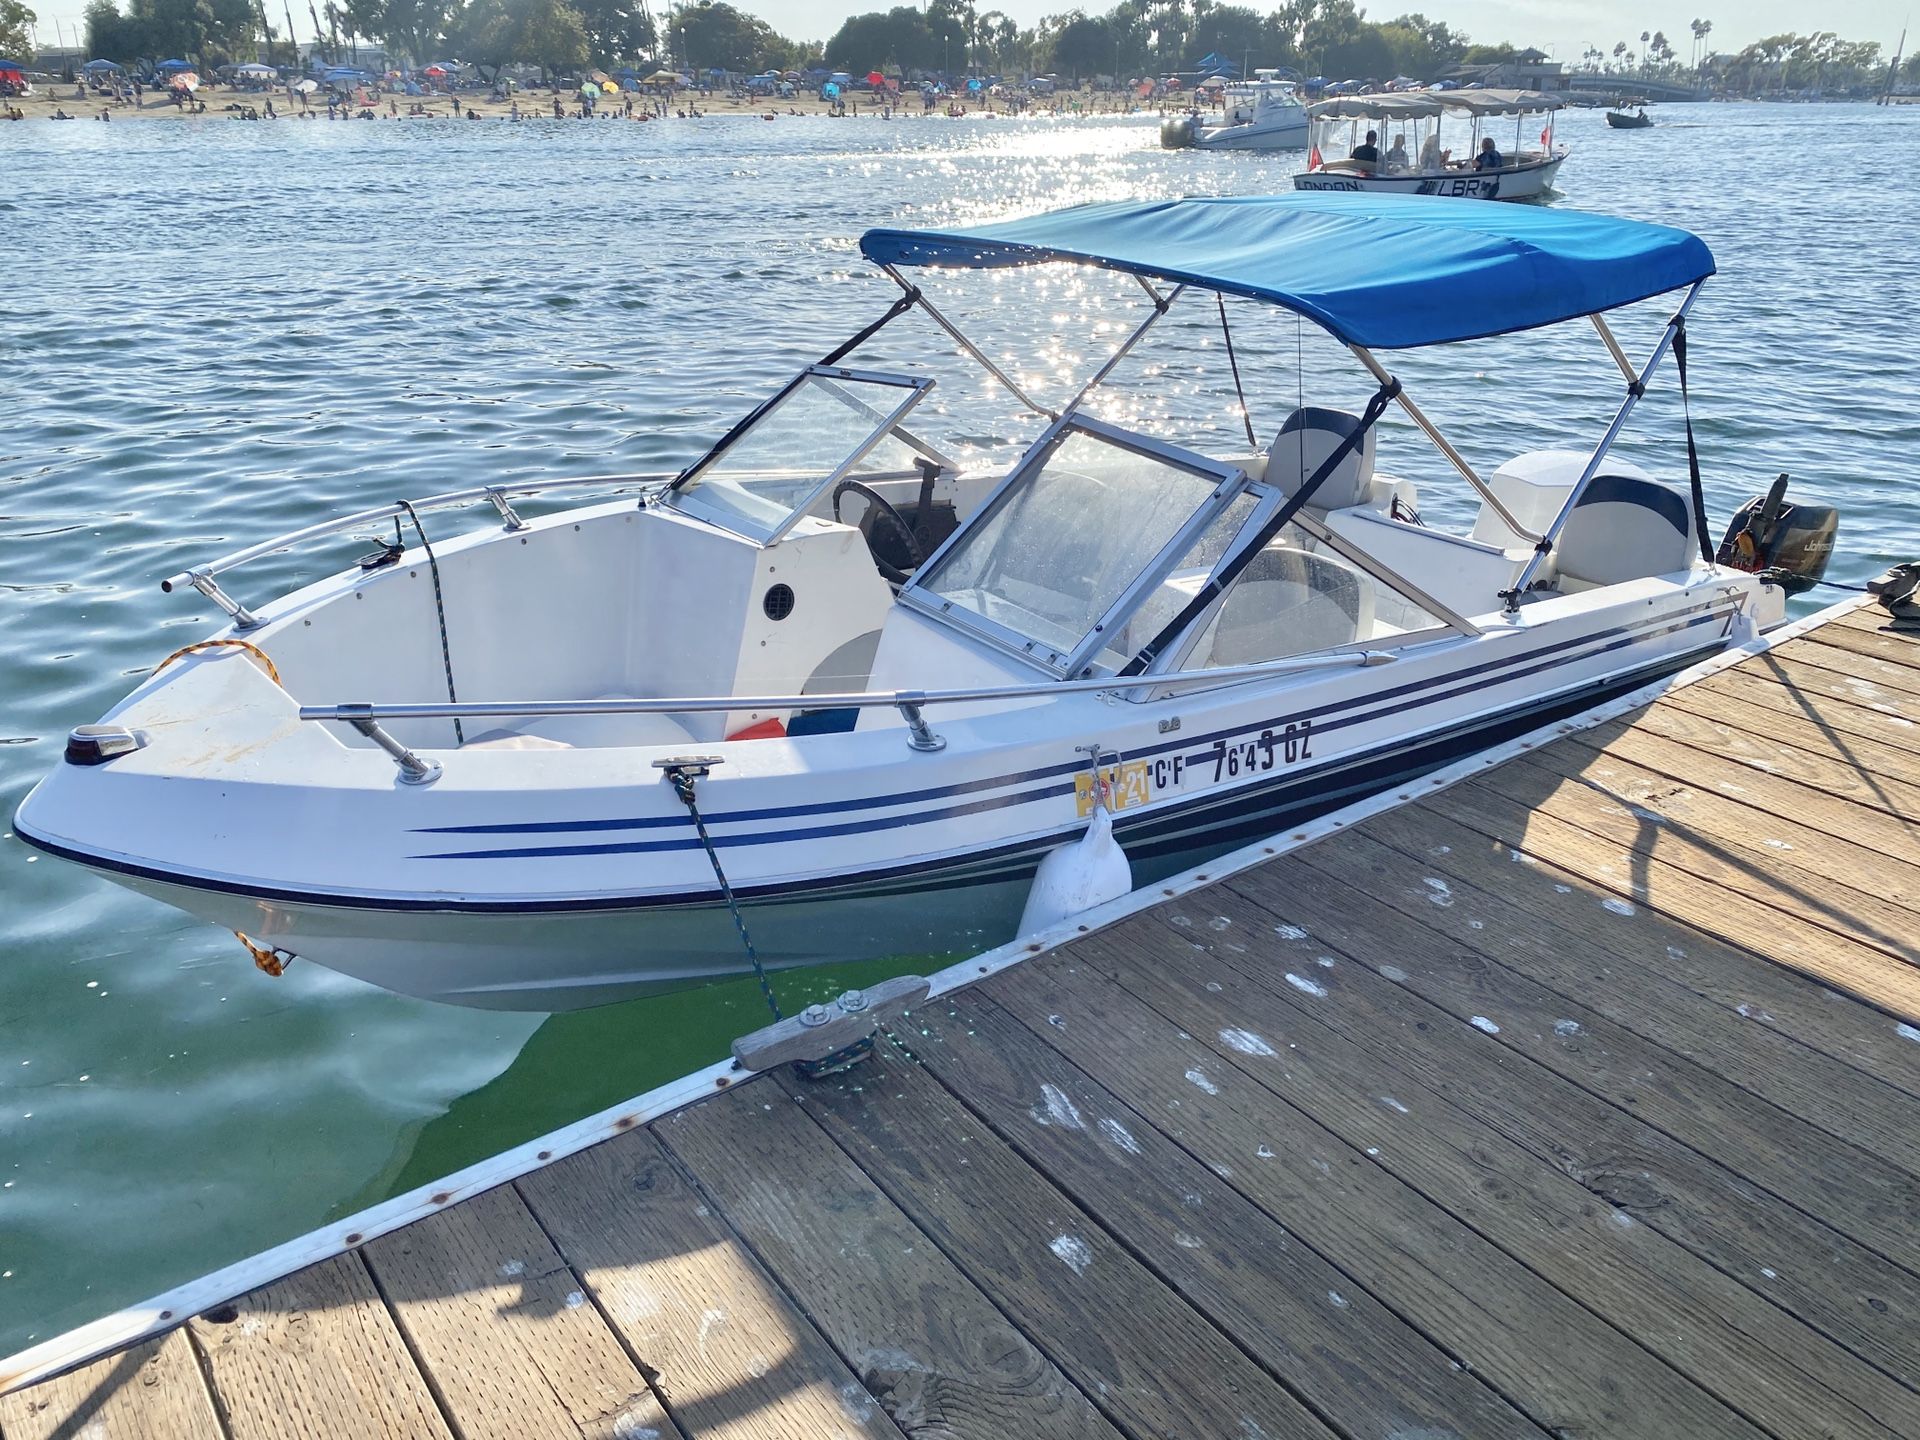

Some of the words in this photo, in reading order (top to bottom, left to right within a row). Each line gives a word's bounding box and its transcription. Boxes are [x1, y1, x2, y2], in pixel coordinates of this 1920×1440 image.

[1296, 181, 1359, 192] LONDON
[1437, 180, 1480, 197] LBR
[1156, 756, 1183, 789] CF
[1213, 730, 1274, 783] 7643
[1127, 769, 1146, 799] 21
